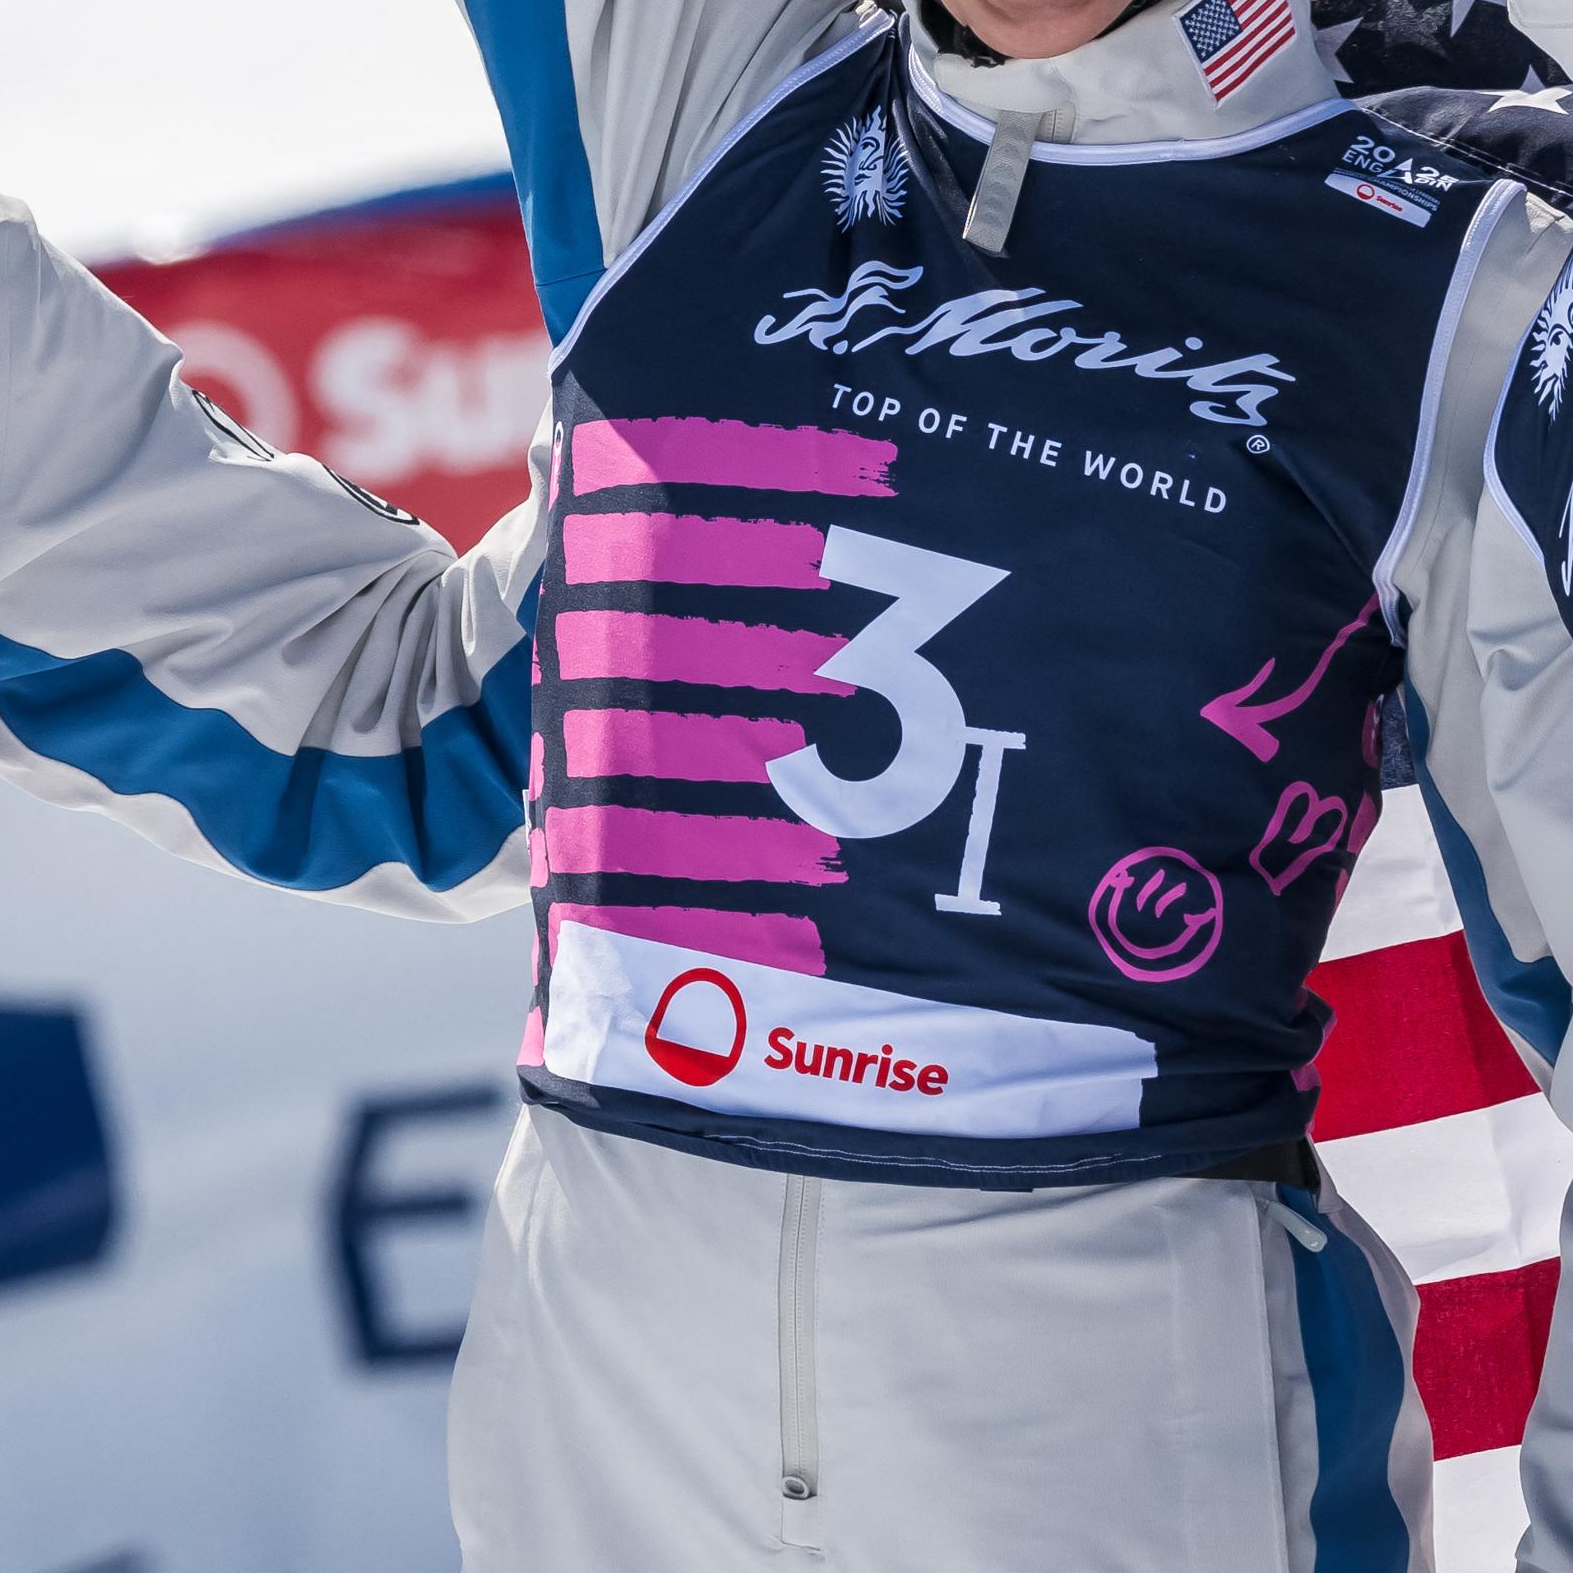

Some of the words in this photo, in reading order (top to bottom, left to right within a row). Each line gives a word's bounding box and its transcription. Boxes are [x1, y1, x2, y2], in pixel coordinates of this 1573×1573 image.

[852, 287, 1296, 426] Moritz
[832, 383, 901, 422] TOP
[918, 407, 968, 439] OF
[987, 422, 1062, 467] THE
[1084, 450, 1227, 513] WORLD
[765, 524, 1012, 839] 3
[764, 1026, 949, 1095] Sunrise
